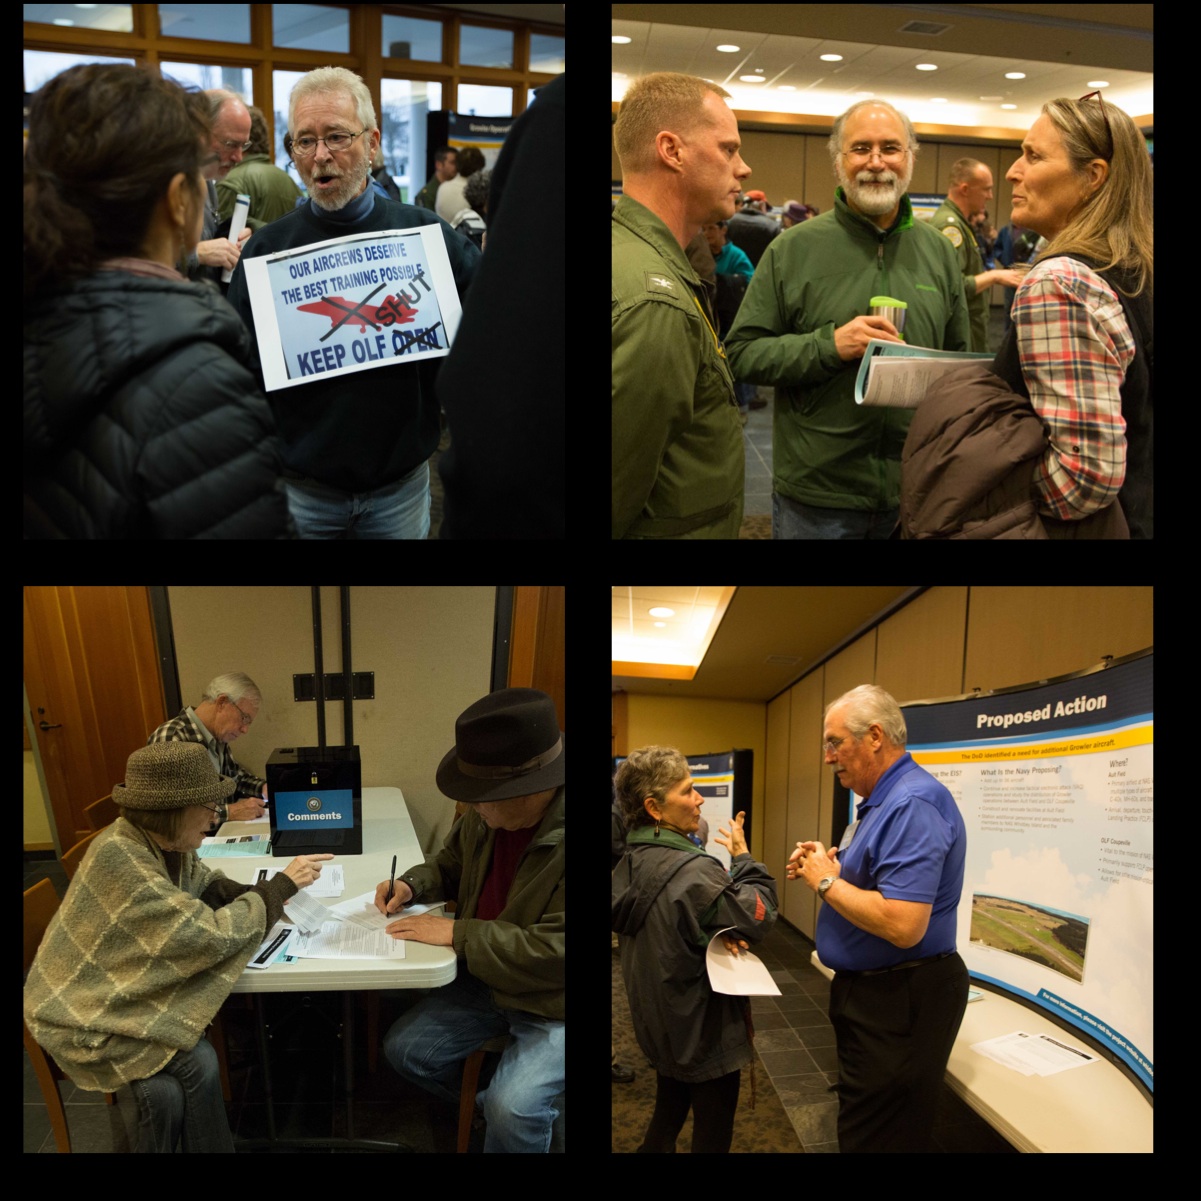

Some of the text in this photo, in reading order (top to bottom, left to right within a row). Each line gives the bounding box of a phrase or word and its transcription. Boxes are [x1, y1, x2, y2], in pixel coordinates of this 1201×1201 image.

[289, 243, 407, 279] OUR AIRCREWS DESERVE
[281, 264, 422, 304] THE BEST TRAINING POSSIBLE
[375, 271, 431, 327] SHUT
[297, 328, 439, 376] KEEP OLF OPEN
[977, 695, 1107, 728] Proposed Action
[1041, 746, 1068, 755] additional
[1093, 740, 1115, 748] aircraft.
[1110, 758, 1128, 768] Where?
[1016, 767, 1030, 775] Navy
[1032, 765, 1062, 774] Proposing?
[288, 812, 342, 821] Comments
